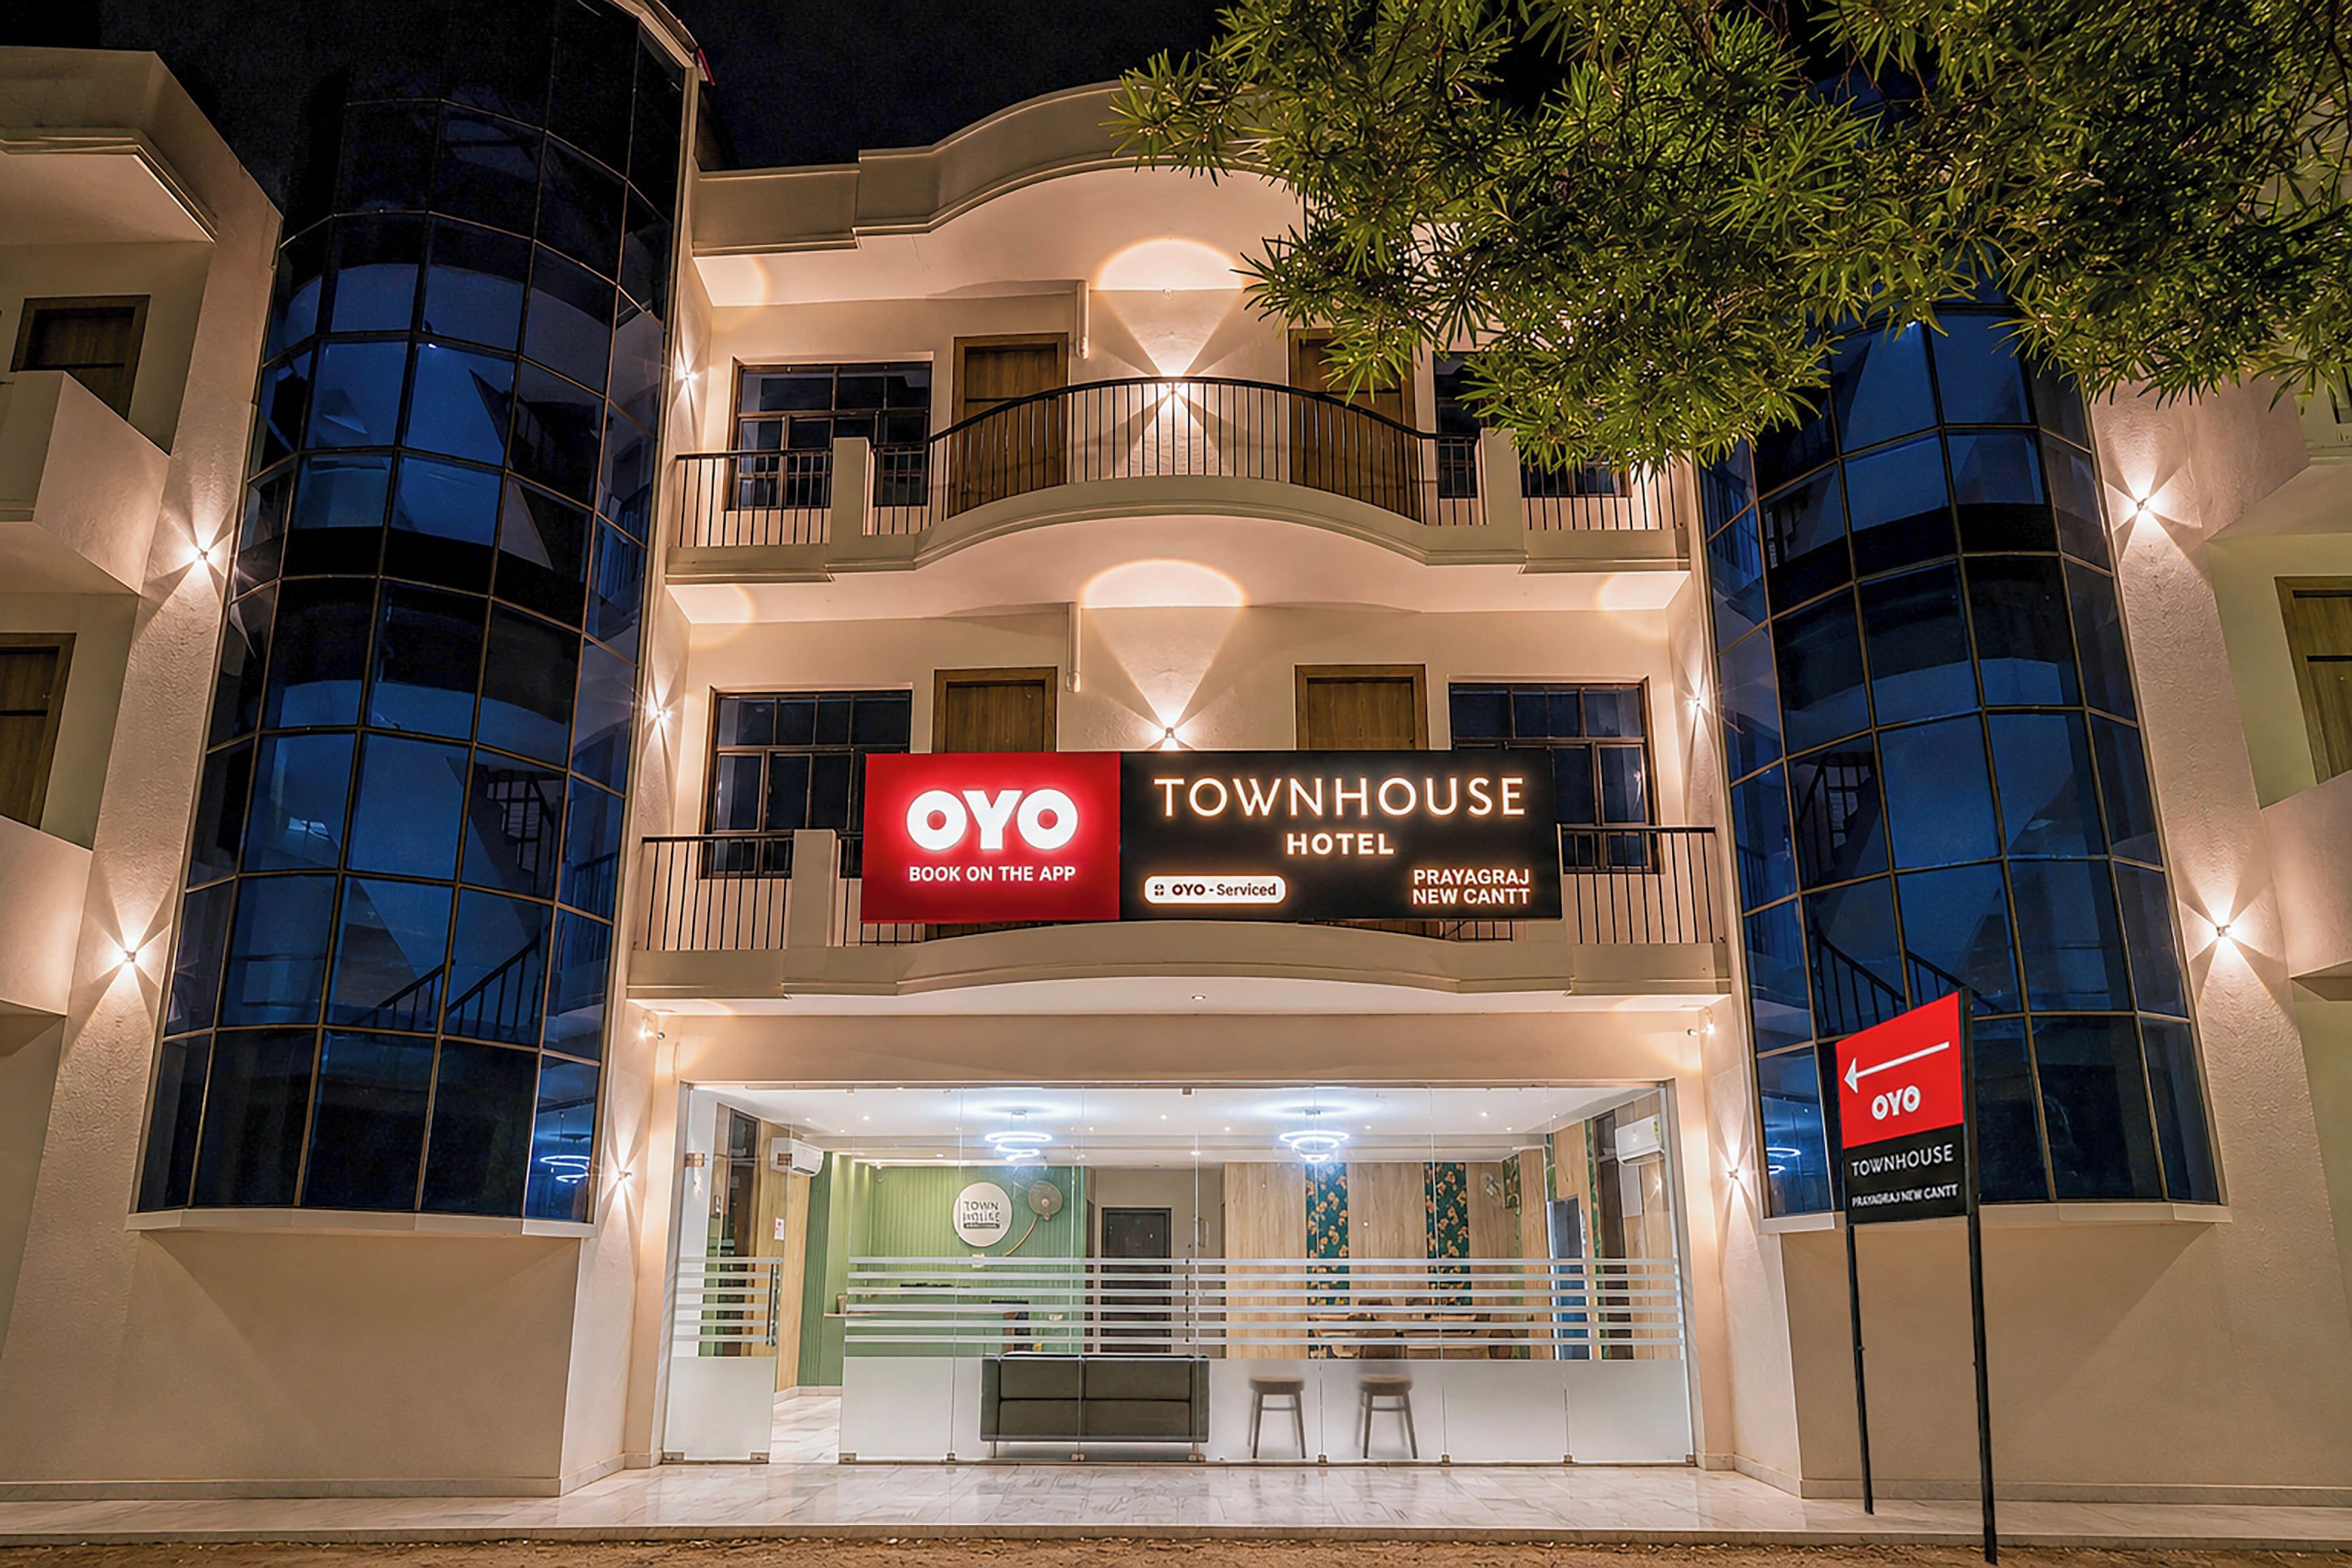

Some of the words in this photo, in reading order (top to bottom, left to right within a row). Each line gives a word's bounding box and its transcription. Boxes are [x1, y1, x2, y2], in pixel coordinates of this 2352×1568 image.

[1154, 777, 1526, 817] TOWNHOUSE
[906, 789, 1078, 850] OYO
[1286, 832, 1394, 855] HOTEL
[909, 866, 960, 881] BOOK
[966, 866, 992, 881] ON
[998, 866, 1033, 881] THE
[1039, 866, 1076, 881] APP
[1414, 868, 1530, 885] PRAYAGRAJ
[1172, 883, 1206, 896] OYO
[1412, 888, 1458, 905] NEW
[1463, 887, 1531, 905] CANTT
[1872, 1085, 1921, 1120] OYO
[1850, 1143, 1954, 1177] TOWNHOUSE
[1901, 1188, 1923, 1202] NEW
[1923, 1183, 1958, 1200] CANTT
[964, 1201, 998, 1211] TOWN
